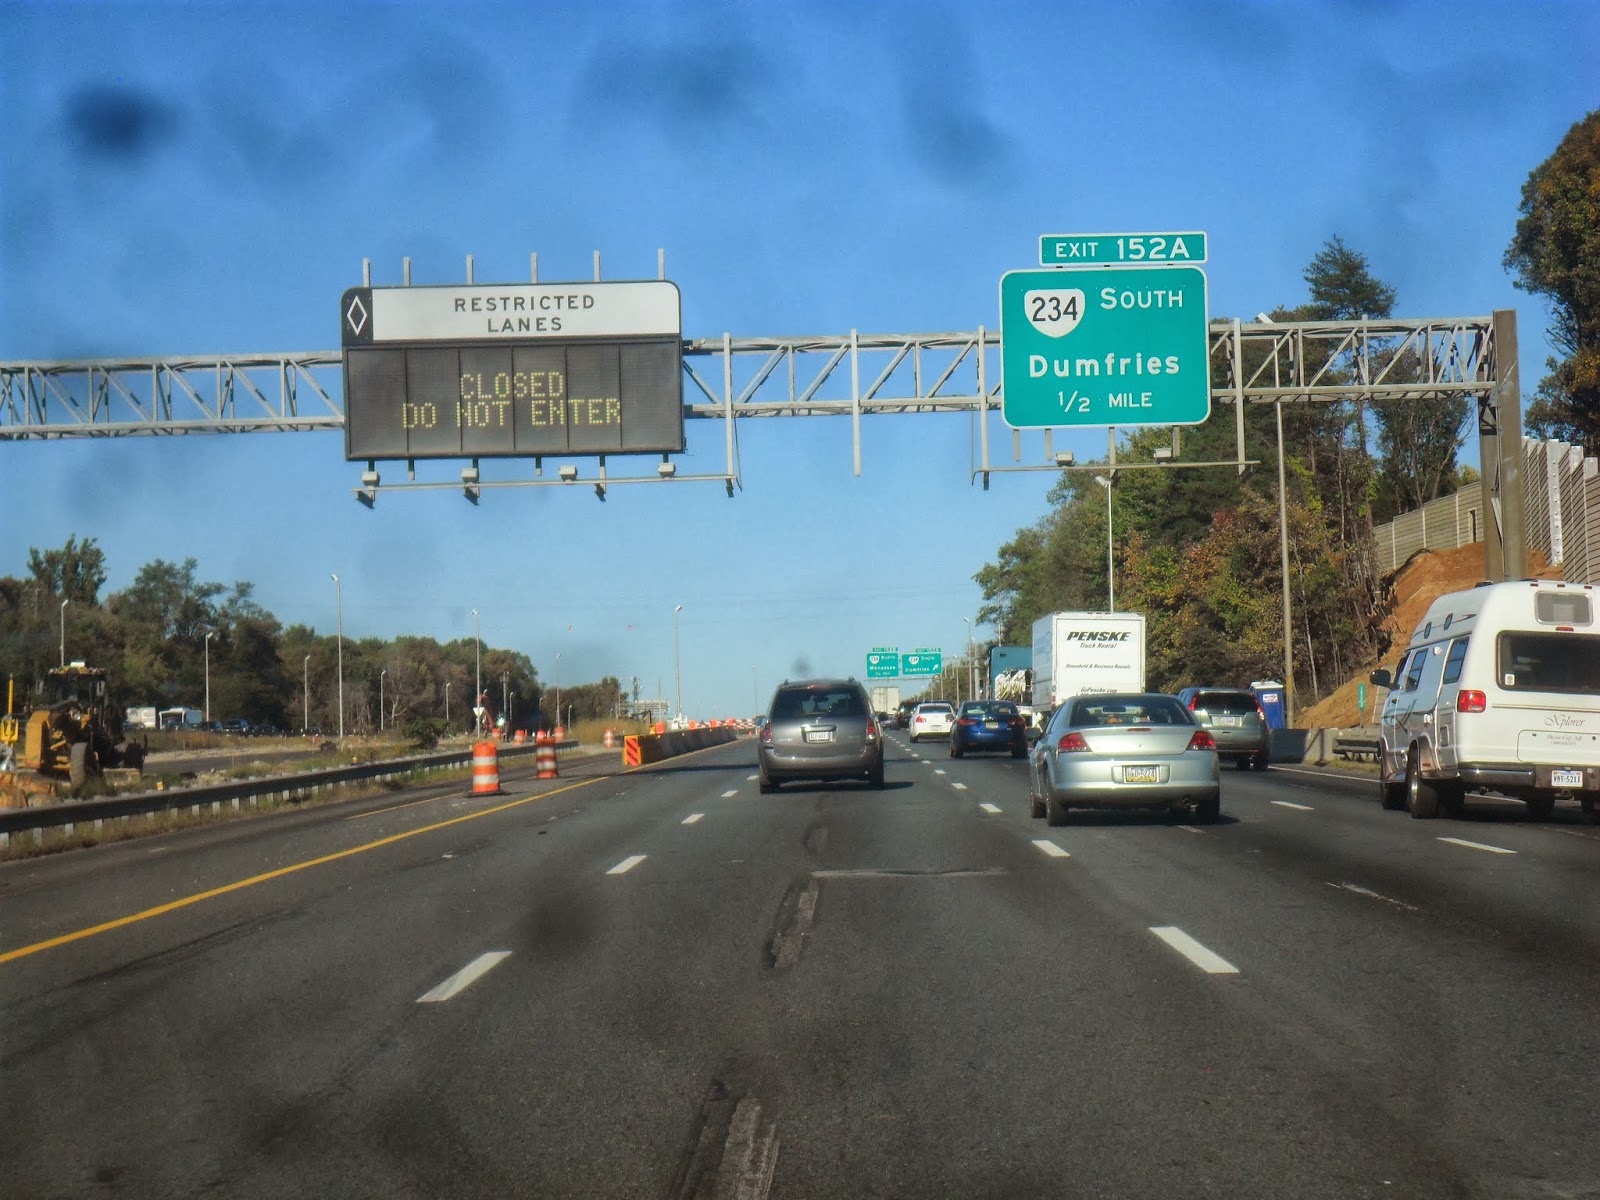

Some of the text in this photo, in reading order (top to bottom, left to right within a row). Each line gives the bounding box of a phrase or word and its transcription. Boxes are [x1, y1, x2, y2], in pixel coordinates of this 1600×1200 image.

[1055, 237, 1190, 260] EXIT 152A
[454, 295, 595, 312] RESTRICTED
[1031, 296, 1078, 322] 234
[1100, 287, 1183, 310] SOUTH
[487, 317, 563, 333] LANES
[1029, 352, 1180, 378] Dumfries
[460, 371, 564, 399] CLOSED
[402, 397, 621, 429] DO NOT ENTER
[1058, 390, 1153, 413] 1/2 MILE
[1066, 631, 1131, 642] PENSKE
[1544, 714, 1586, 730] Xplorer
